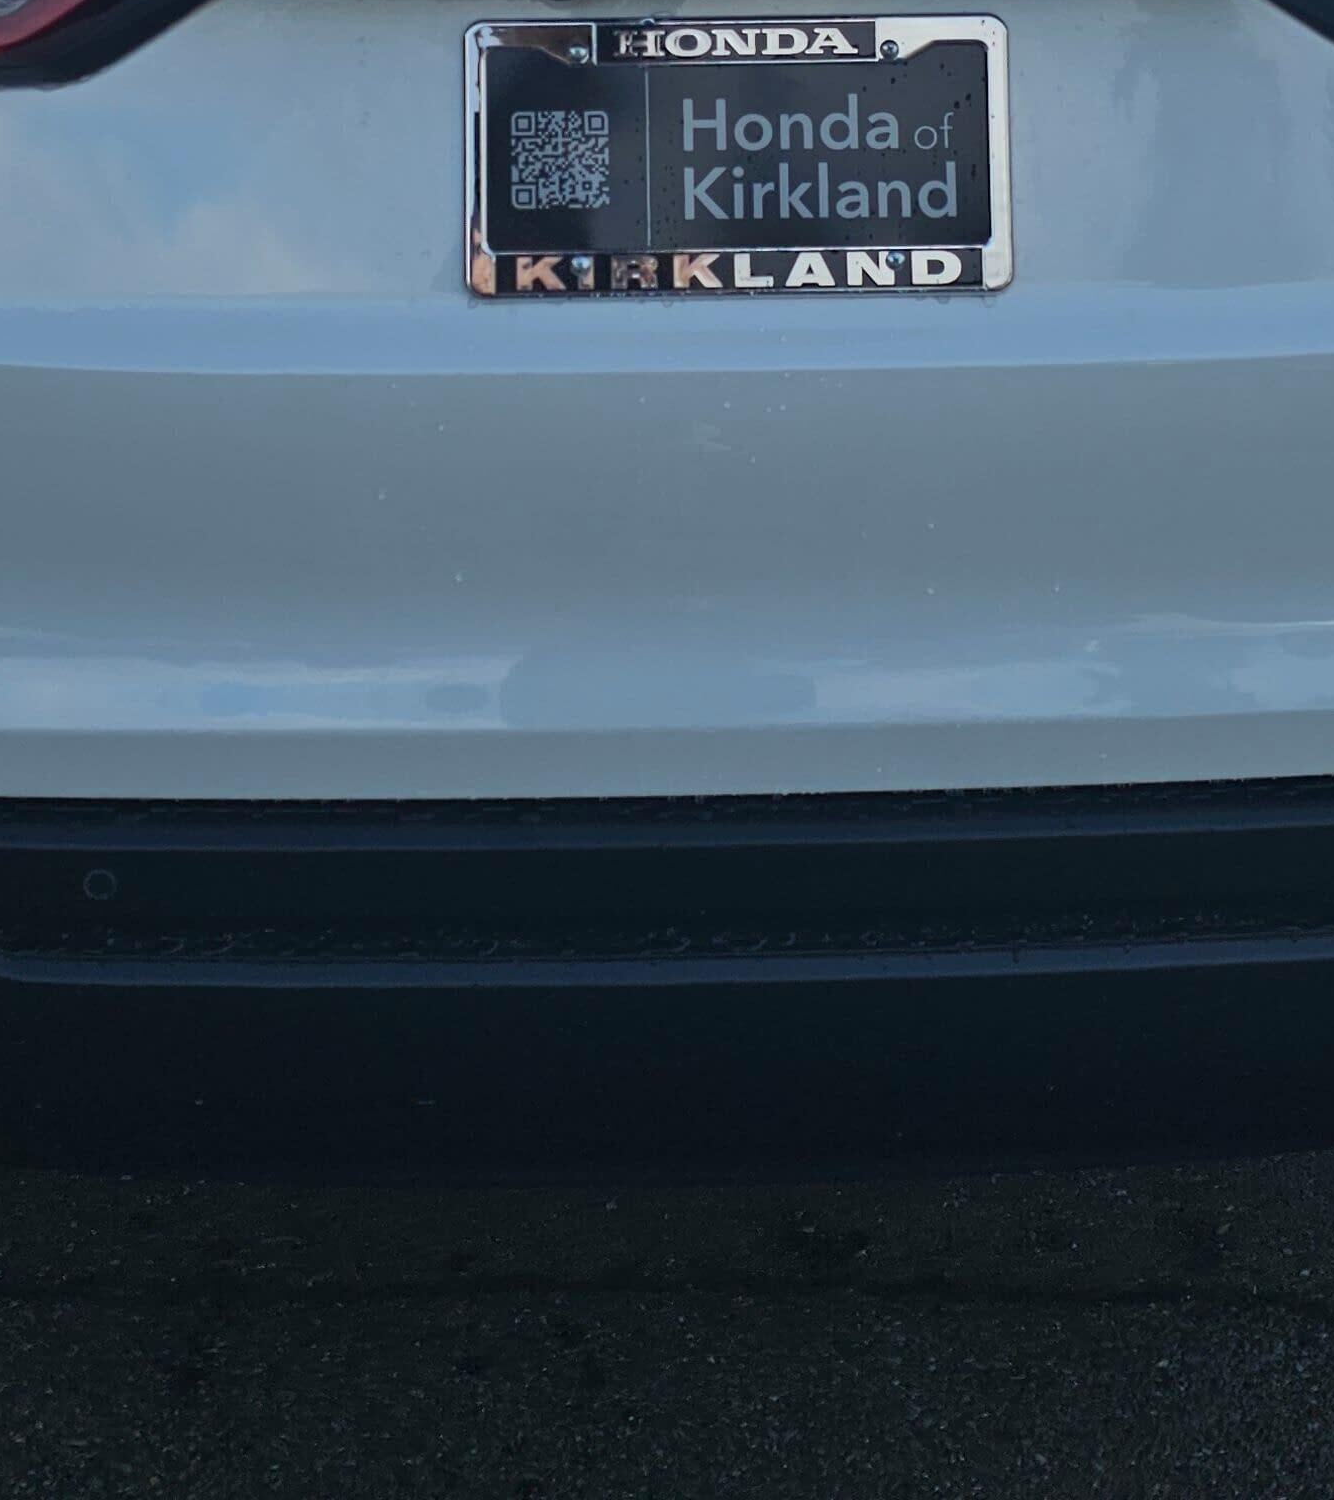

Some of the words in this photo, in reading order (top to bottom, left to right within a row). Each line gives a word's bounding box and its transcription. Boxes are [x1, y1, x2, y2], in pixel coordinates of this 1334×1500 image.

[615, 27, 858, 59] HONDA
[682, 93, 900, 152] Honda
[913, 111, 954, 150] of
[683, 161, 958, 221] Kirkland
[517, 251, 962, 289] KIRKLAND
